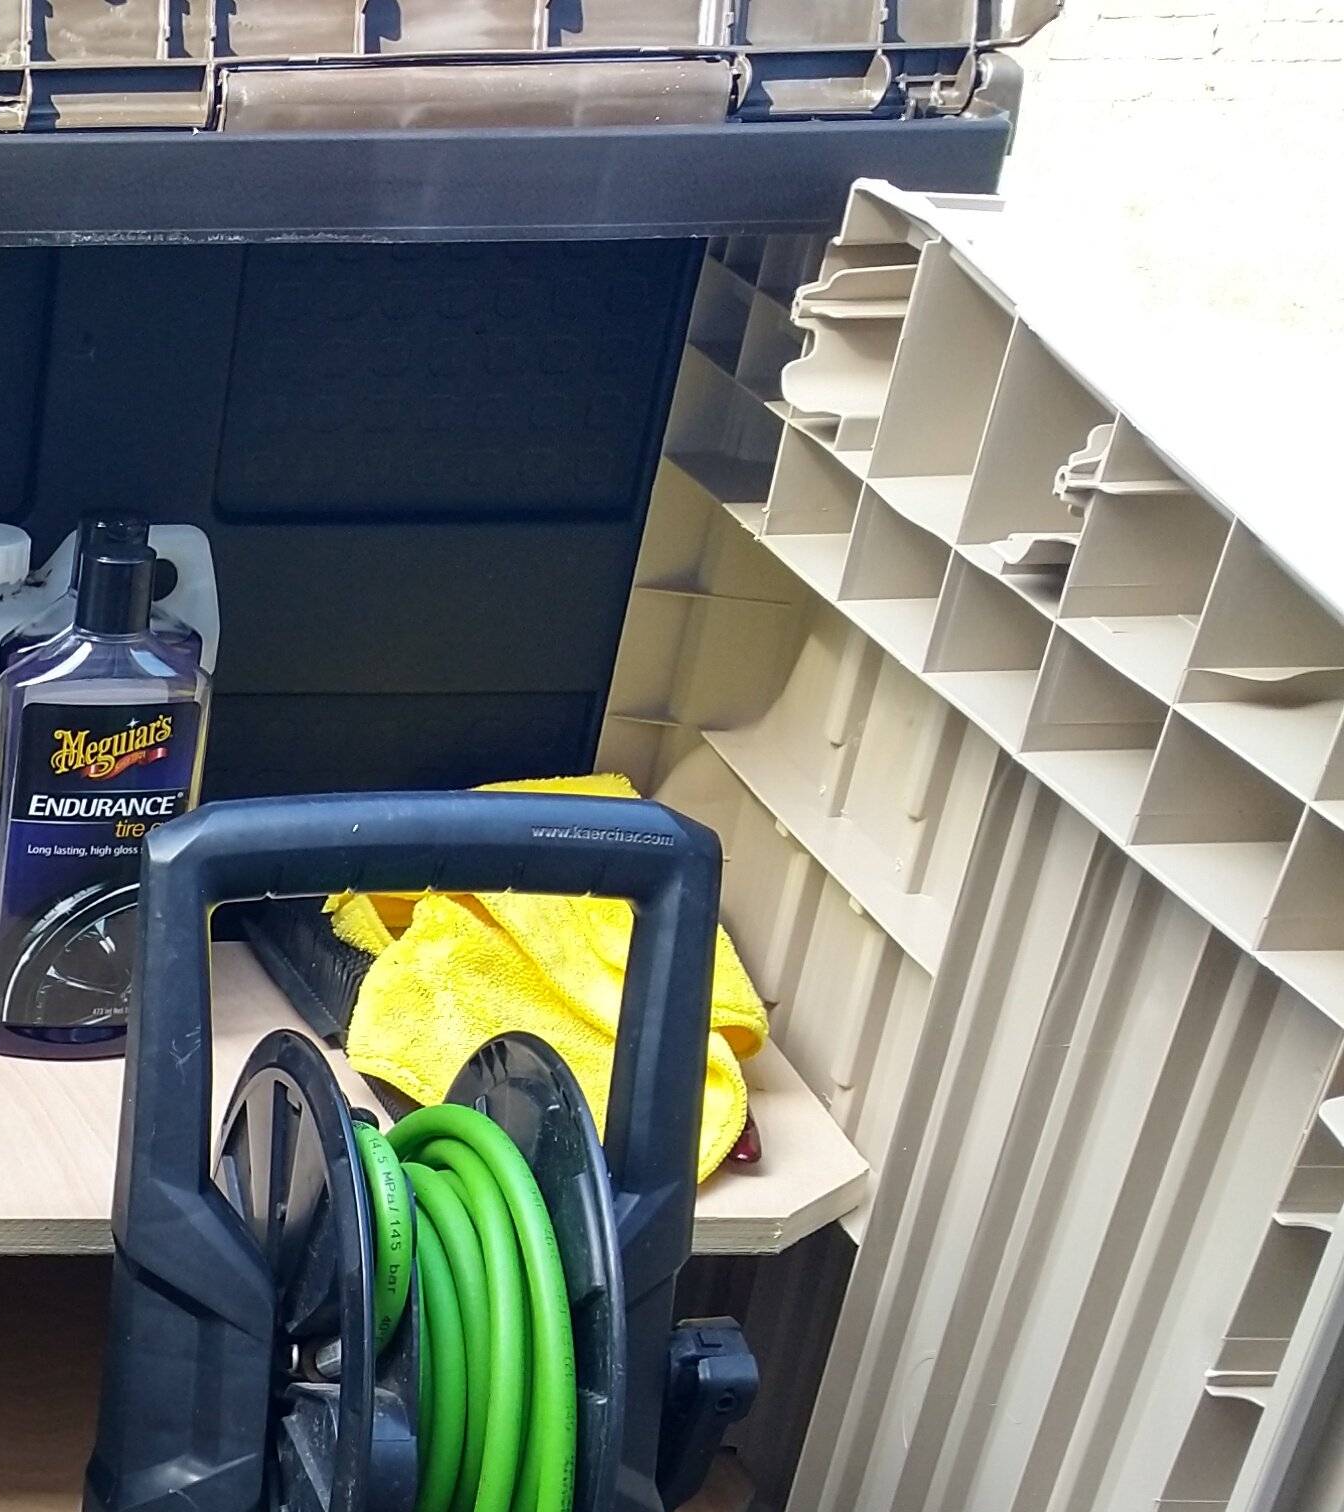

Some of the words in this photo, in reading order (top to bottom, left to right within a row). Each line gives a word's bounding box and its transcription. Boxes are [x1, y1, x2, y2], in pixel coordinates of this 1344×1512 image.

[50, 714, 173, 778] Meguiar's
[28, 794, 176, 818] ENDURANCE
[115, 820, 145, 838] tire
[531, 824, 674, 847] www.kaercher.com
[27, 844, 52, 857] Long
[53, 844, 88, 858] lasting,
[90, 845, 112, 858] high
[113, 845, 138, 858] gloss
[390, 1219, 402, 1251] 145
[386, 1264, 401, 1295] bar
